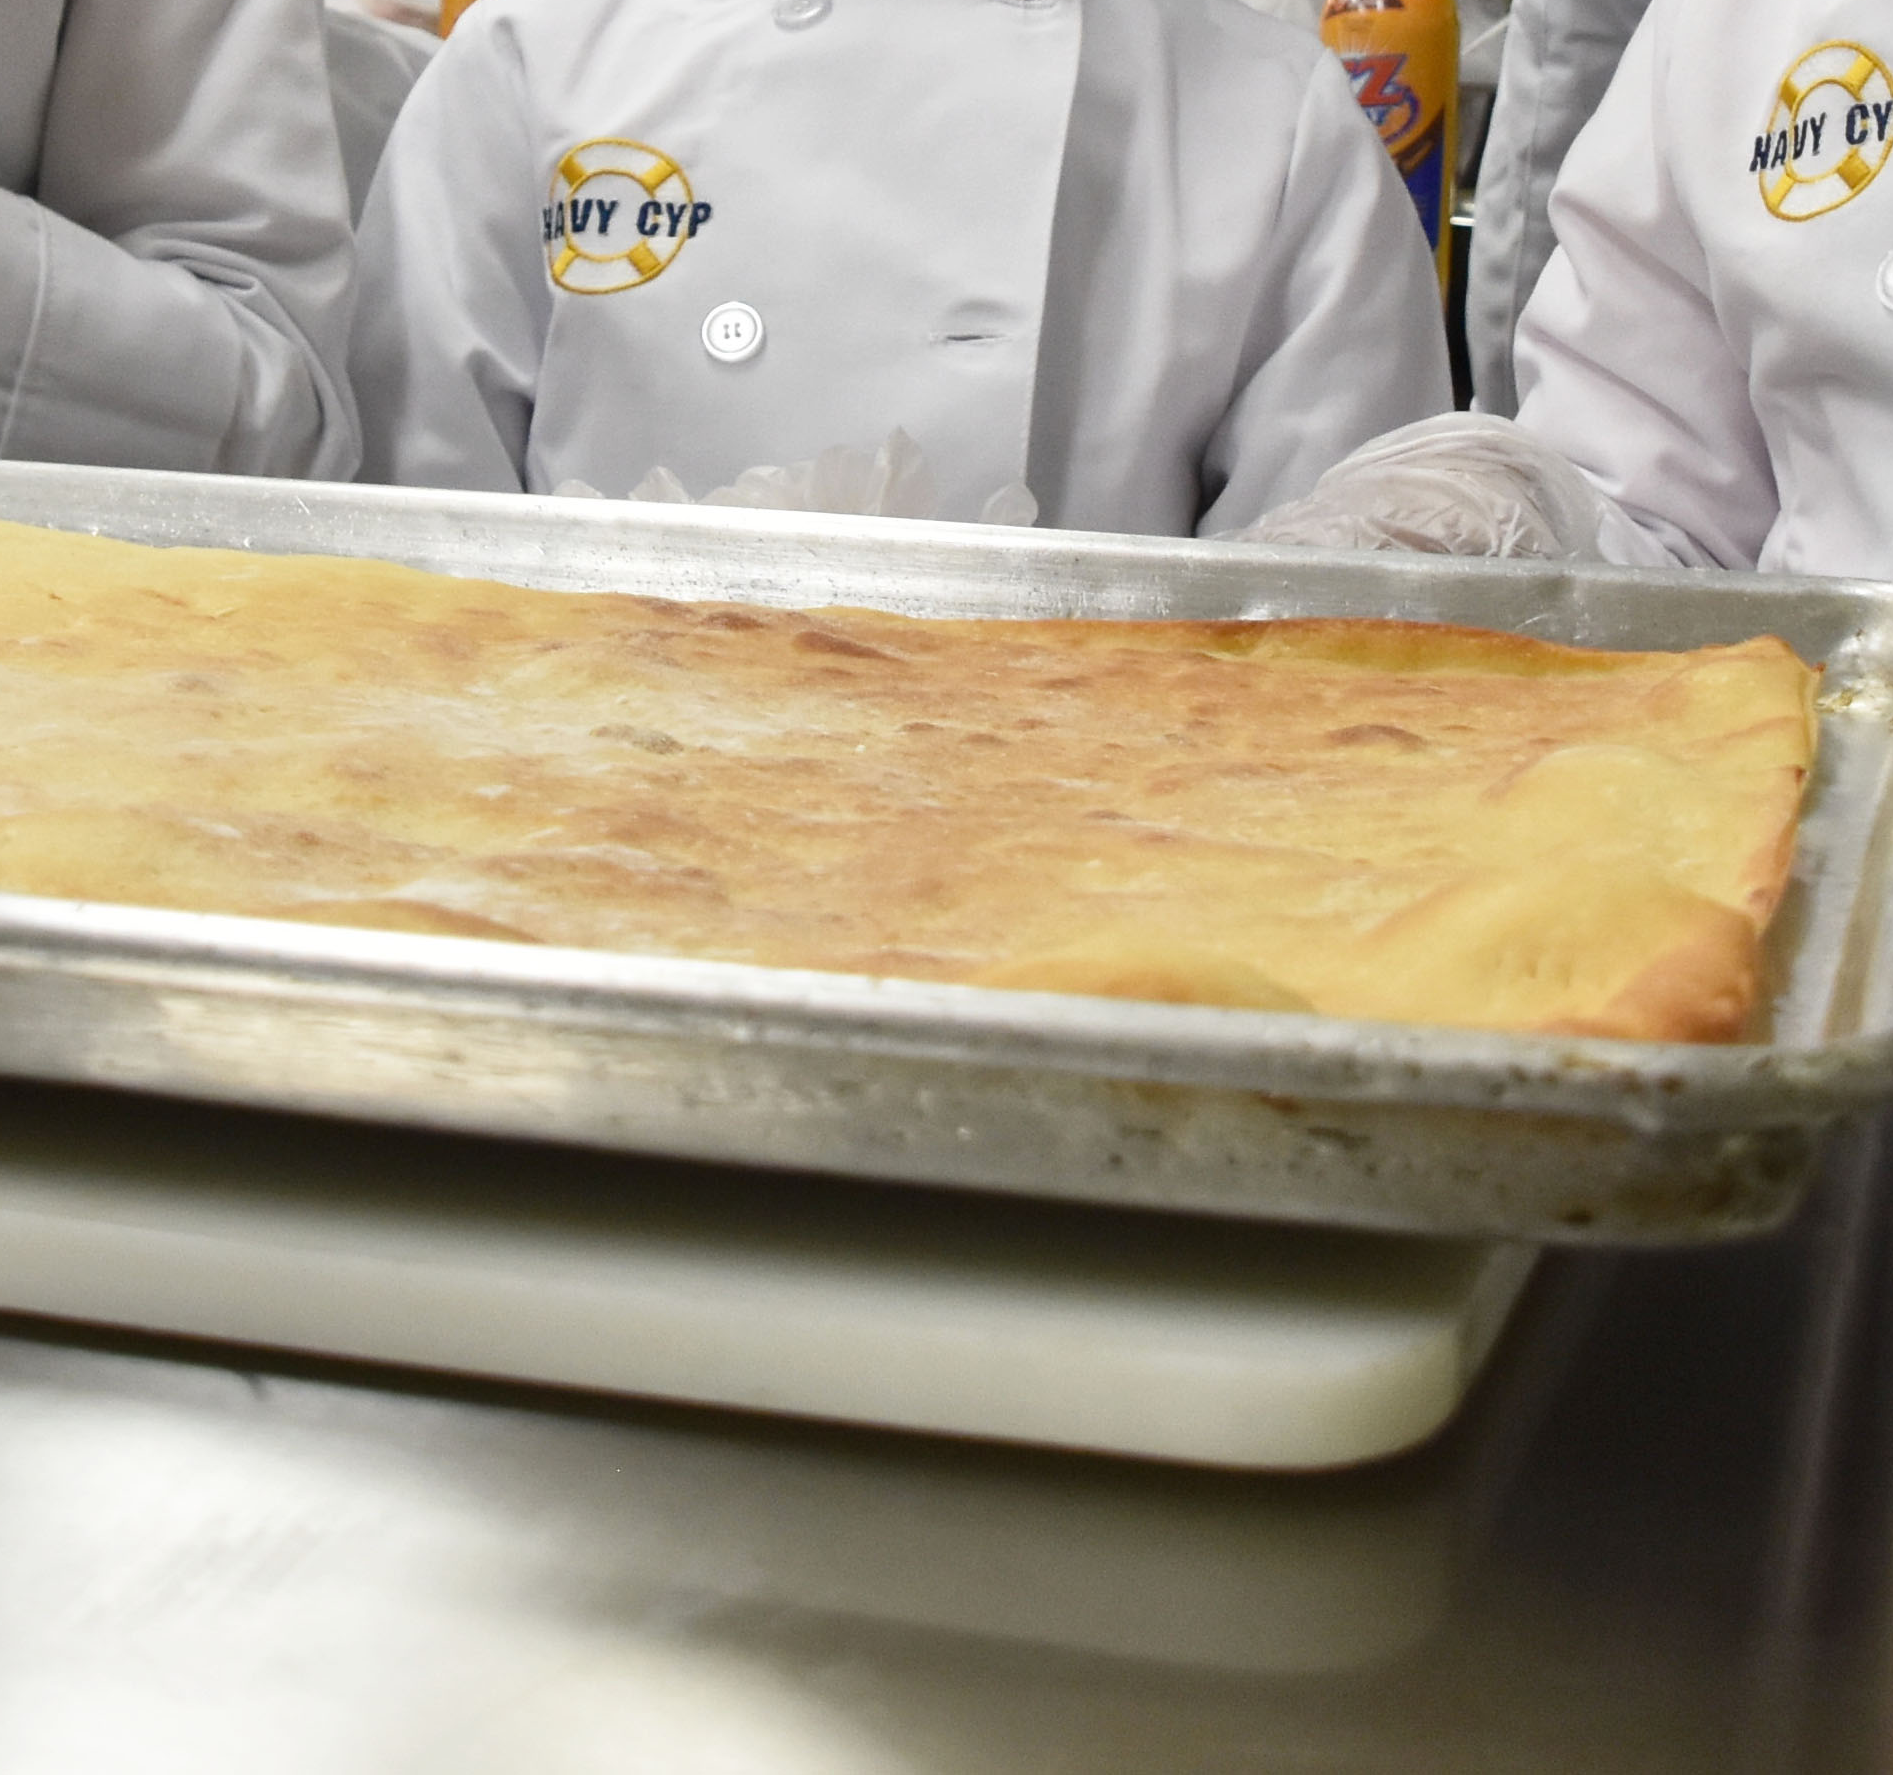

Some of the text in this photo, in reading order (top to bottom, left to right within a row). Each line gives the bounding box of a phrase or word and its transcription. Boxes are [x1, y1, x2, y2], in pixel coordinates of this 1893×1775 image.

[1749, 112, 1826, 172] NAVY
[543, 198, 713, 243] NAVY CYP
